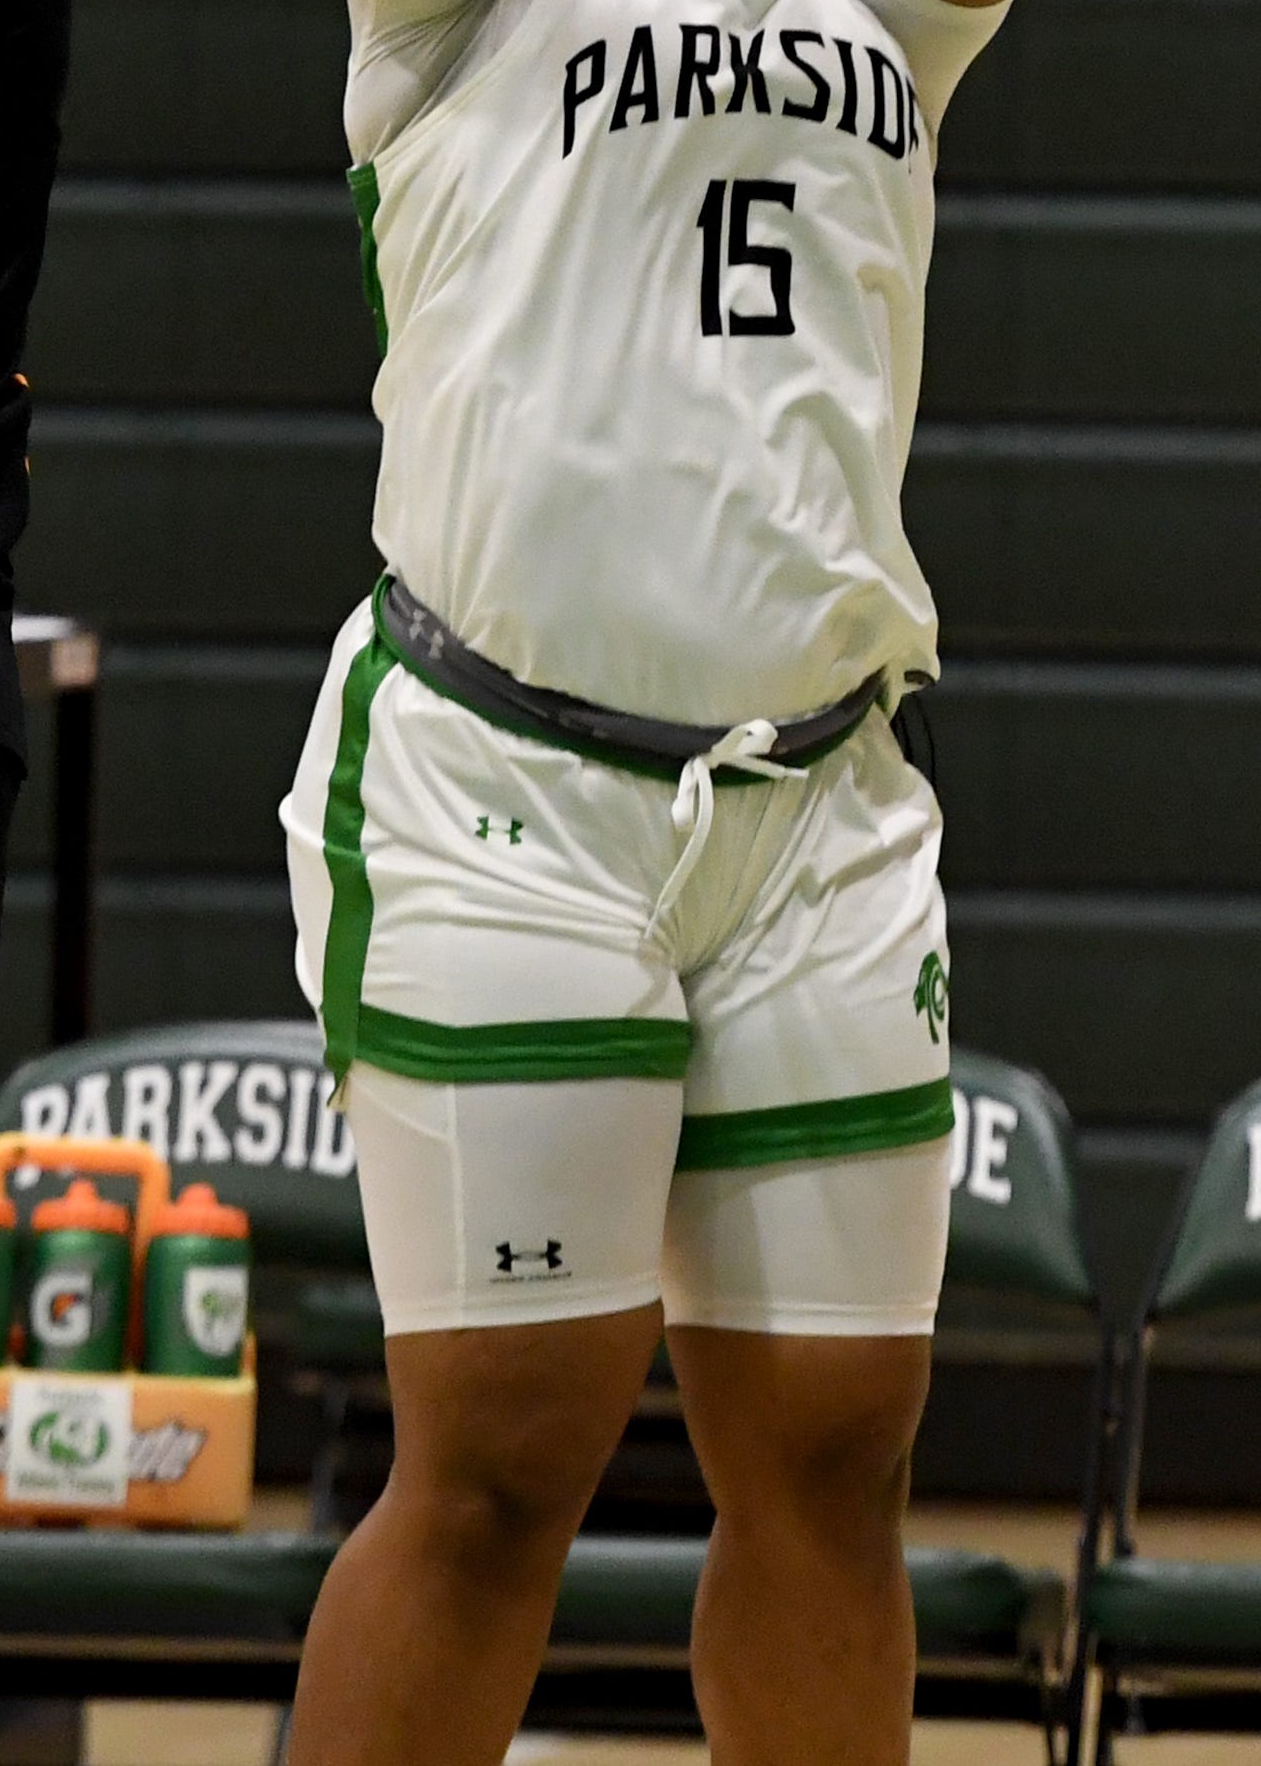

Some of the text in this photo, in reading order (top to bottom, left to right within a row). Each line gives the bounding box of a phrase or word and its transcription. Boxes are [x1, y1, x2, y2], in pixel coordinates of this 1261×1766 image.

[696, 179, 796, 338] 15
[14, 1060, 356, 1190] PARKSID
[30, 1269, 93, 1348] G
